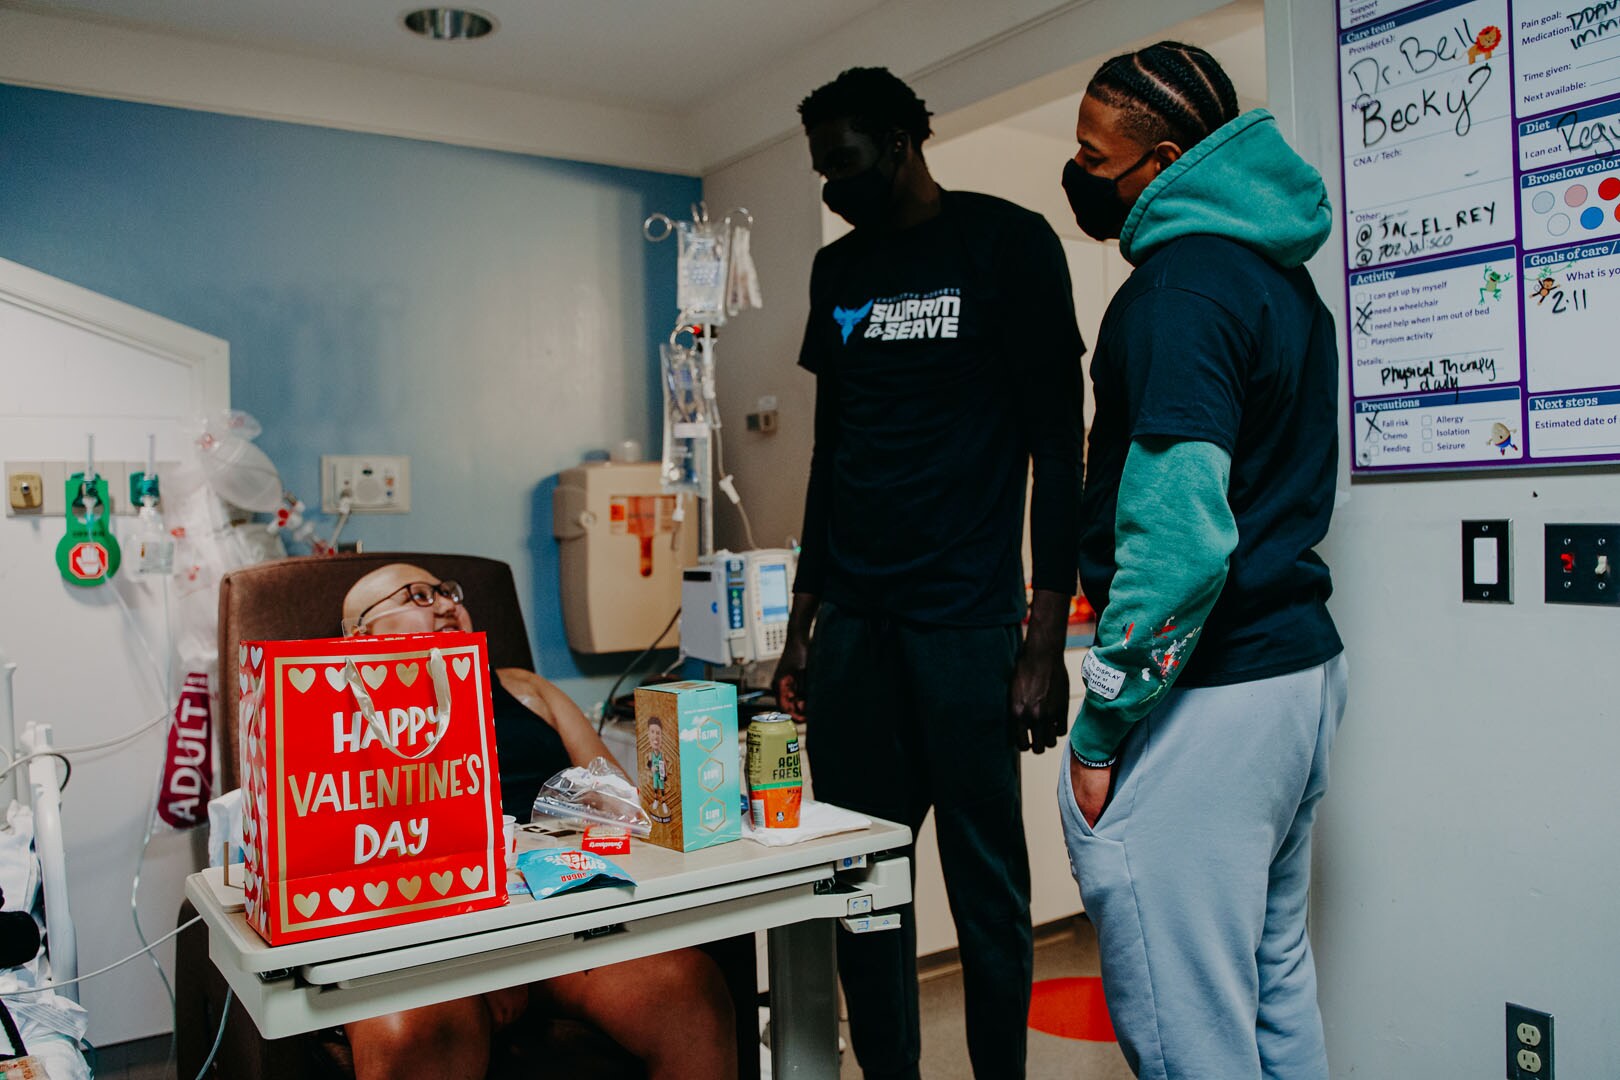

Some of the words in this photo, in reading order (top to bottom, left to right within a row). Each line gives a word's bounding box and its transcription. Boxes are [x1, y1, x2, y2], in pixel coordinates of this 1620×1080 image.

[1521, 19, 1539, 30] Pain
[1541, 10, 1562, 25] goal:
[1346, 29, 1370, 43] Care
[1371, 20, 1396, 33] team
[1521, 25, 1573, 46] Medication:
[1349, 34, 1396, 56] Provider(s):
[1348, 57, 1401, 94] Dr.
[1400, 18, 1478, 74] Bell
[1523, 71, 1543, 83] Time
[1544, 63, 1572, 77] given:
[1523, 91, 1544, 104] Next
[1545, 81, 1587, 98] available:
[1526, 120, 1551, 135] Diet
[1353, 154, 1373, 168] CNA
[1382, 148, 1402, 161] Tech:
[1530, 147, 1546, 158] can
[1547, 143, 1562, 154] eat
[1527, 165, 1585, 187] Broselow
[1355, 211, 1380, 223] Other:
[1530, 251, 1564, 267] Goals
[1568, 247, 1581, 260] of
[1581, 245, 1609, 259] care
[1356, 269, 1396, 285] Activity
[1566, 268, 1595, 282] What
[1597, 267, 1606, 277] is
[1373, 292, 1387, 300] can
[1388, 289, 1399, 301] get
[1400, 288, 1410, 299] up
[1411, 285, 1421, 296] by
[1422, 281, 1448, 293] myself
[869, 295, 961, 323] SWARM
[1374, 304, 1392, 315] need
[1399, 299, 1439, 313] wheelchair
[1375, 320, 1393, 331] need
[1393, 317, 1410, 330] help
[1411, 316, 1430, 326] when
[1436, 314, 1449, 322] am
[1450, 311, 1463, 320] out
[1465, 308, 1473, 318] of
[1474, 306, 1490, 316] bed
[881, 316, 960, 341] SERVE
[1371, 334, 1405, 347] Playroom
[1406, 330, 1434, 342] activity
[1361, 398, 1420, 412] Precautions
[1534, 397, 1562, 411] Next
[1565, 395, 1599, 410] steps
[1382, 420, 1394, 428] Fall
[1395, 418, 1409, 427] risk
[1436, 415, 1464, 425] Allergy
[1535, 417, 1582, 430] Estimated
[1583, 416, 1605, 428] date
[1607, 414, 1618, 426] of
[1382, 431, 1408, 441] Chemo
[1436, 427, 1470, 437] Isolation
[1383, 444, 1411, 454] Feeding
[1437, 442, 1466, 451] Seizure
[1095, 666, 1121, 681] DISPLAY
[333, 705, 444, 754] HAPPY
[167, 698, 209, 821] ADULT
[772, 766, 801, 780] FRES
[288, 753, 482, 818] VALENTINE'S
[354, 817, 429, 865] DAY
